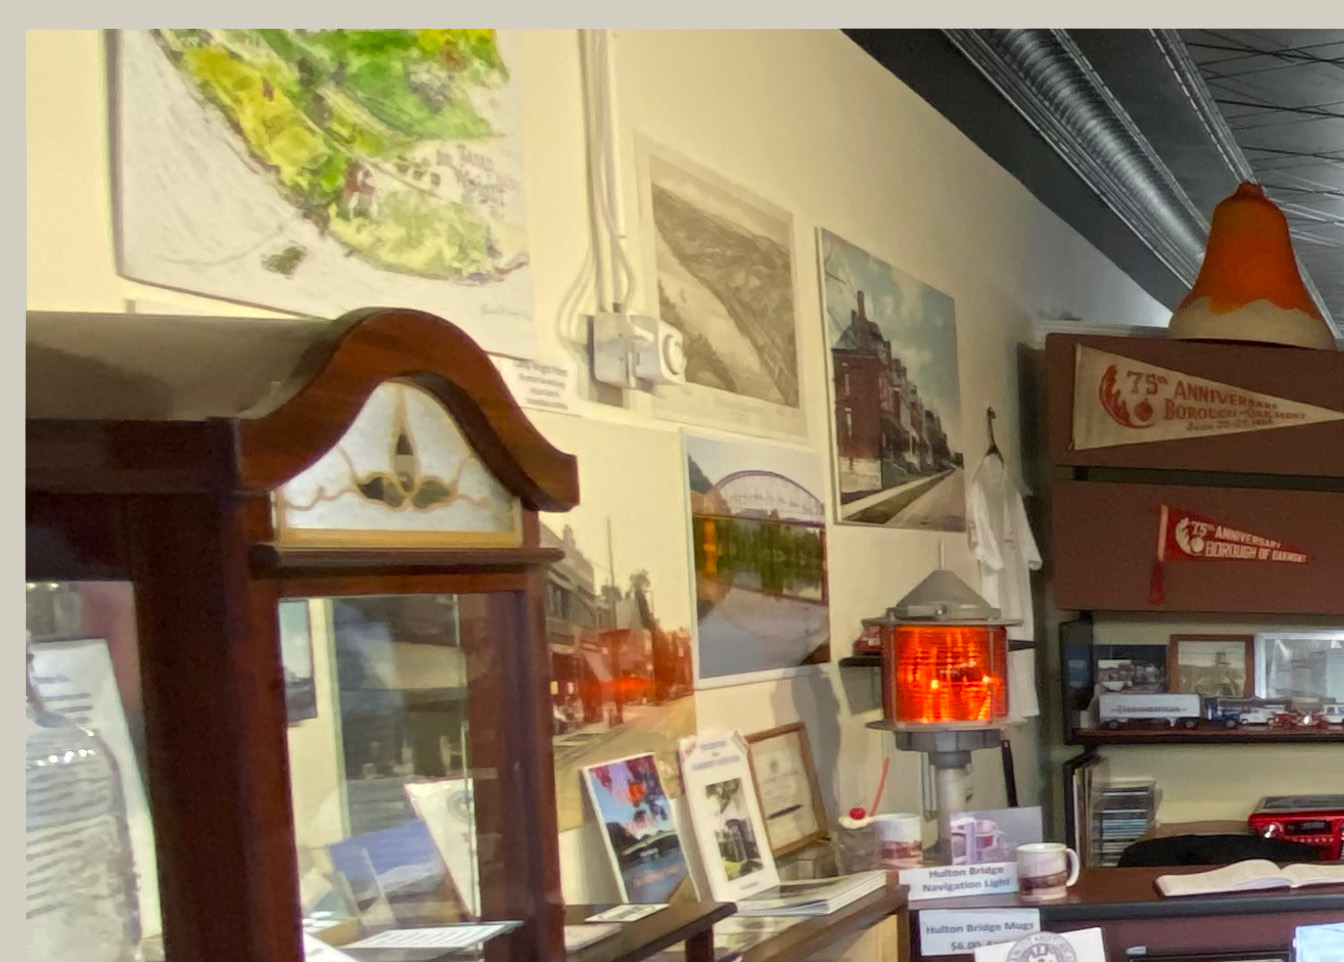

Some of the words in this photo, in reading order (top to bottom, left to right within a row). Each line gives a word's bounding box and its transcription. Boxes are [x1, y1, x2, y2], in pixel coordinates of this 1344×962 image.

[1174, 380, 1279, 411] ANNIVERSARY
[1165, 399, 1239, 421] BOROUGH
[1214, 525, 1282, 550] ANNIVERSARY
[1205, 541, 1258, 560] BOROUGH
[1258, 549, 1271, 561] OF
[1272, 549, 1308, 563] OAKMONT
[928, 869, 967, 879] Hulton
[968, 866, 1005, 876] Bridge
[922, 881, 982, 893] Navigation
[984, 878, 1011, 888] Light
[926, 925, 964, 935] Hulton
[966, 923, 1002, 934] Bridge
[1004, 921, 1035, 932] Mugs
